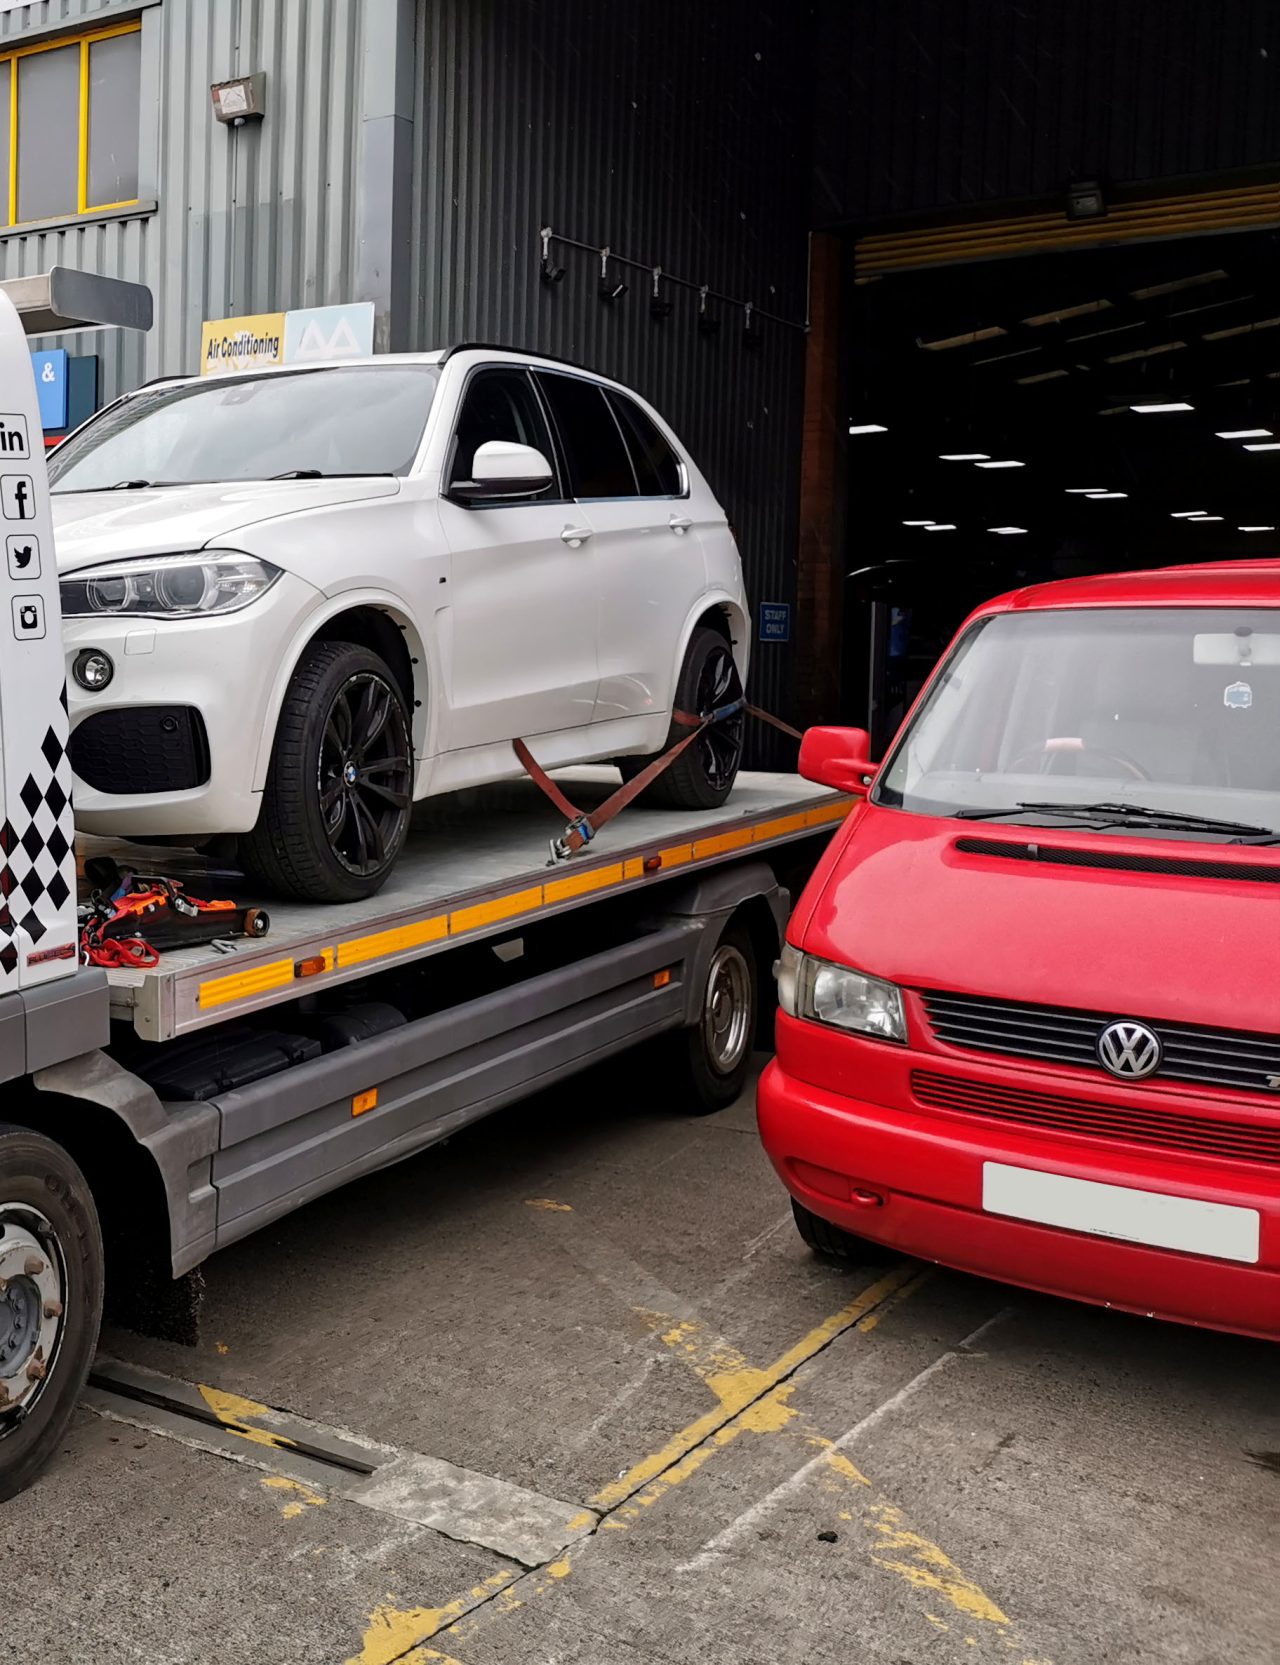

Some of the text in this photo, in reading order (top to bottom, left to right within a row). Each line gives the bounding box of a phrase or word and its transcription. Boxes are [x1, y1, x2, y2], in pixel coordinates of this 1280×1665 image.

[207, 332, 280, 360] Air Conditioning
[764, 610, 787, 620] STAFF
[766, 623, 785, 634] ONLY
